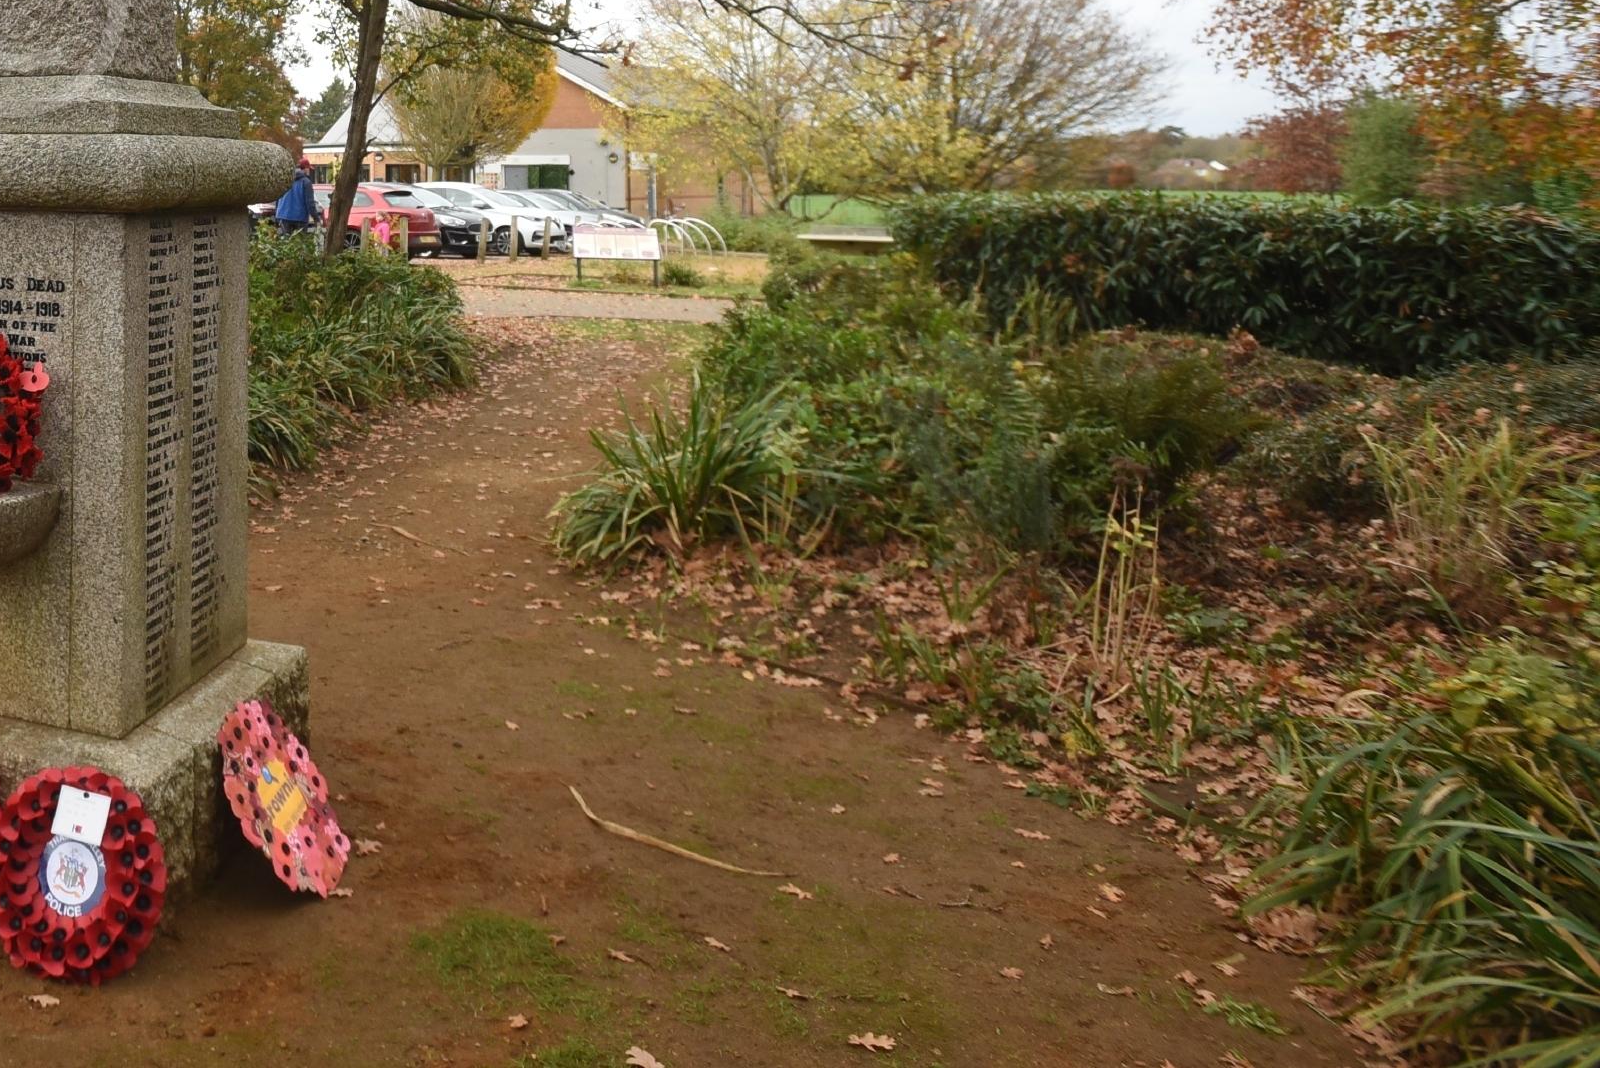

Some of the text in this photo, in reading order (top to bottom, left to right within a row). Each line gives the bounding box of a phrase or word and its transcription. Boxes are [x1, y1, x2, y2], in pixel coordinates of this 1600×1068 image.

[26, 277, 65, 293] DEAD
[11, 320, 27, 330] OF
[31, 321, 57, 332] THE
[7, 334, 36, 347] WAR
[44, 892, 83, 918] POLICE
